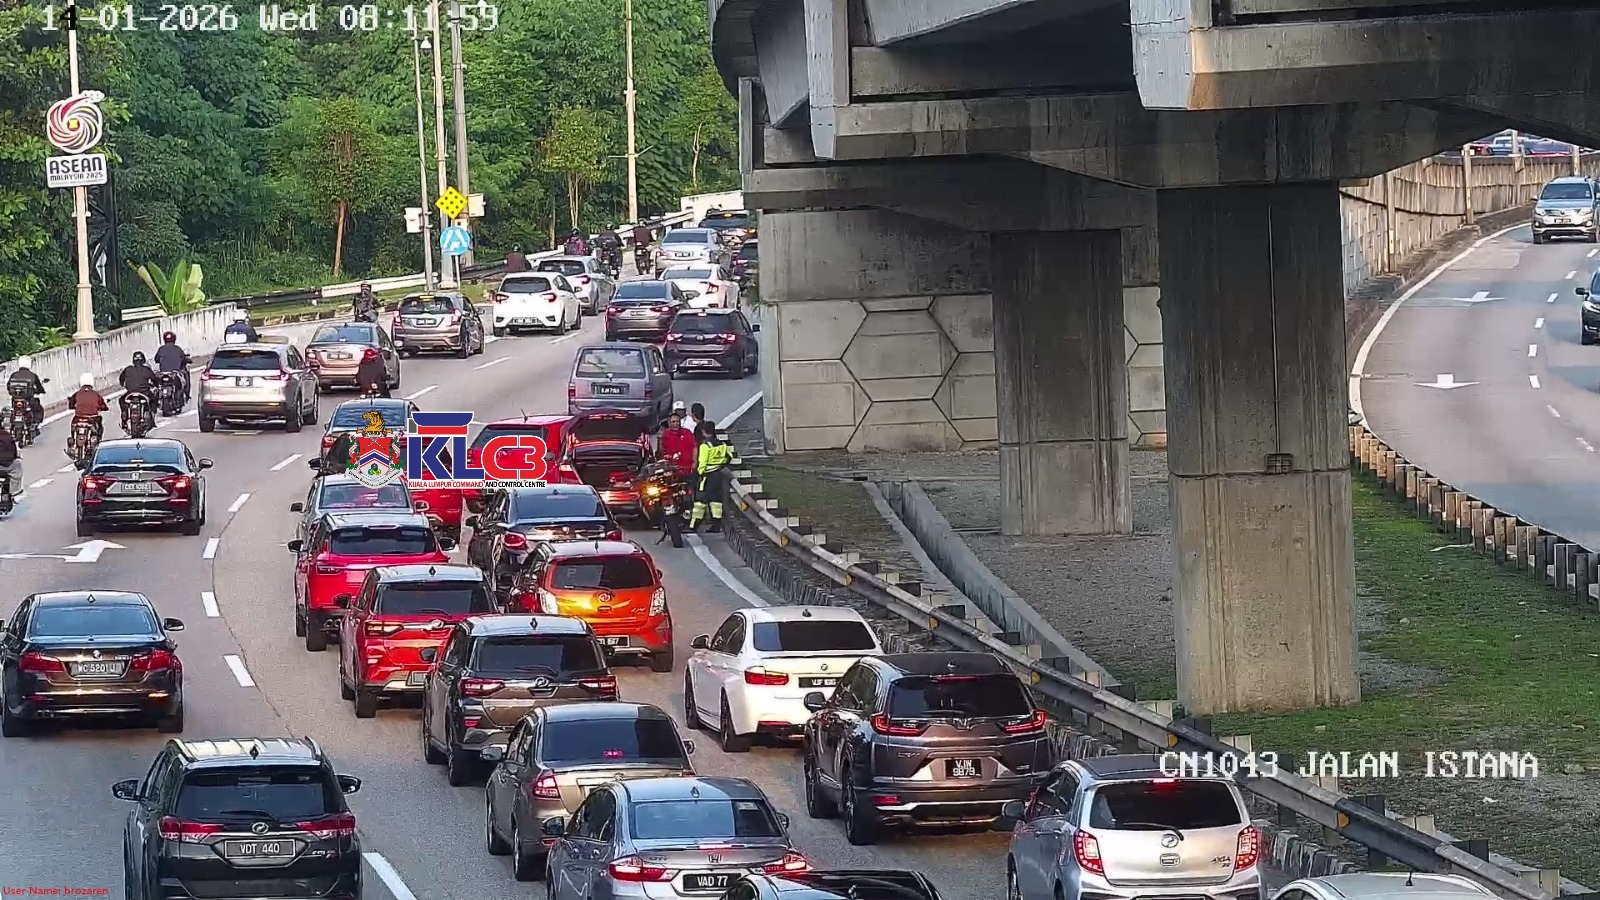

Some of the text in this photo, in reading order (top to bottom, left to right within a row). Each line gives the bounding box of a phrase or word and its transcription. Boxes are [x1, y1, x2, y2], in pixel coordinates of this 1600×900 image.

[50, 157, 102, 174] ASEAN
[240, 843, 280, 854] VDT 440
[697, 875, 728, 887] VAD 77
